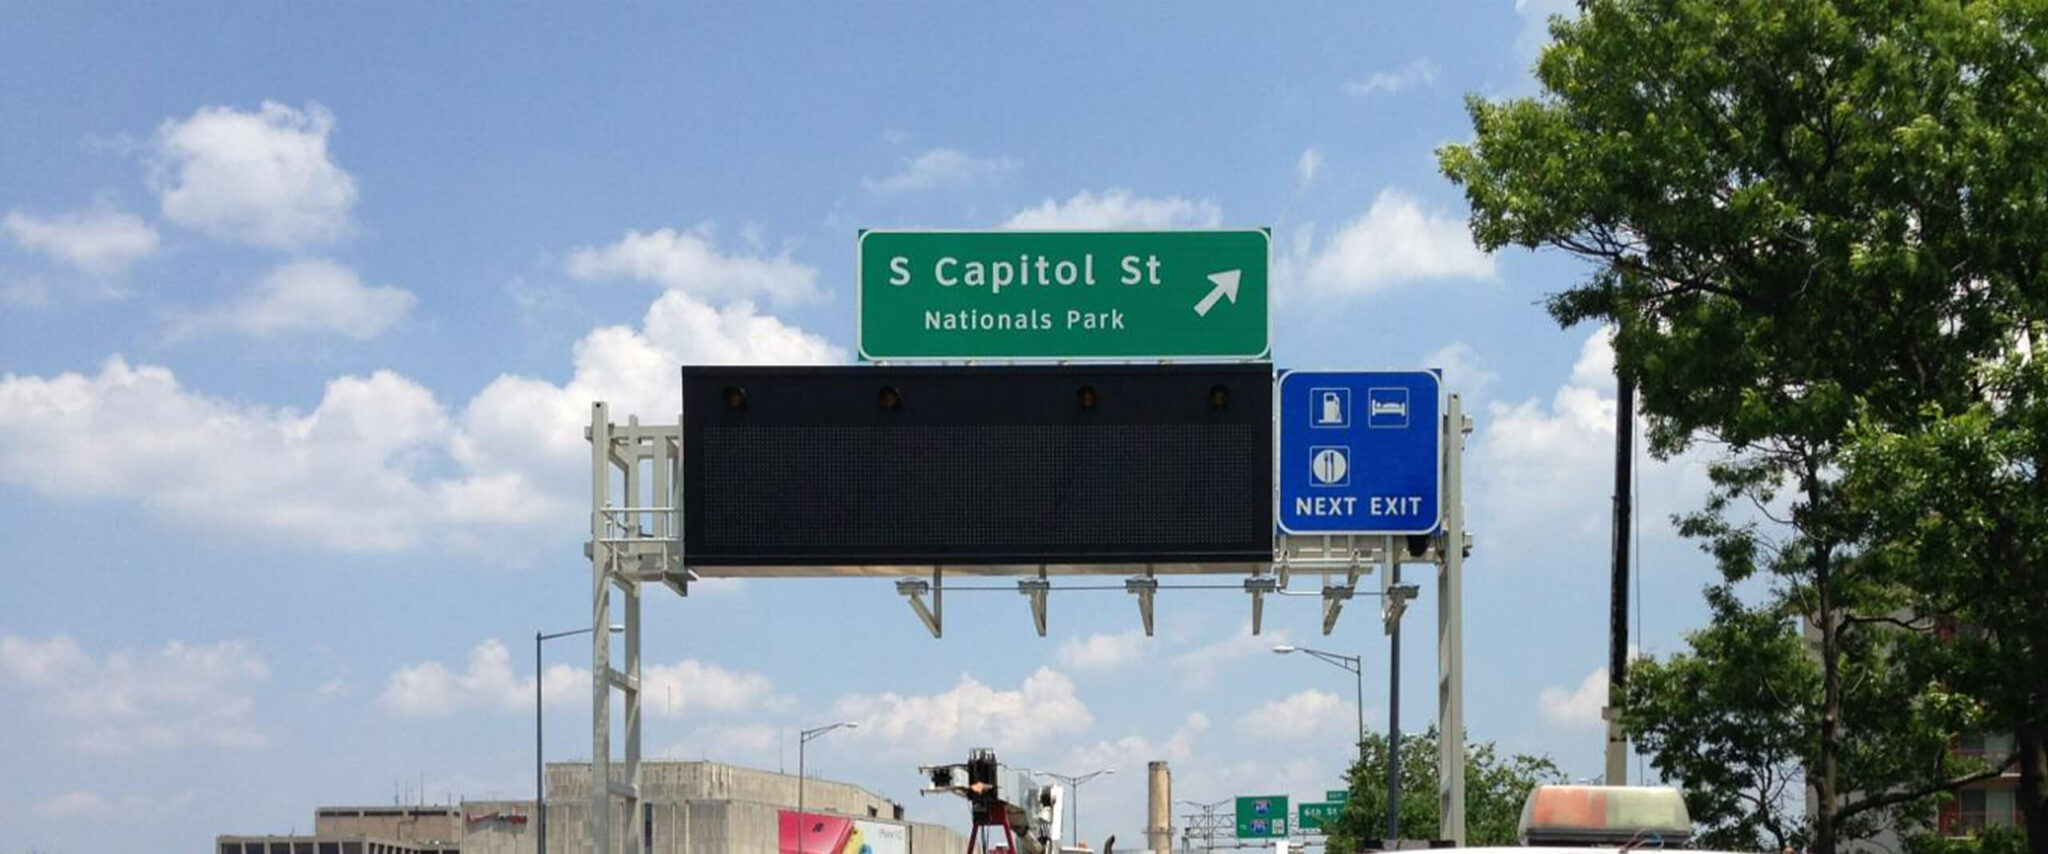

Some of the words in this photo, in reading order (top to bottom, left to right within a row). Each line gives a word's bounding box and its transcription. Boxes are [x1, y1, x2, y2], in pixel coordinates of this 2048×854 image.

[889, 256, 911, 286] S
[934, 253, 1096, 293] Capitol
[1120, 255, 1162, 286] St
[924, 308, 1053, 330] Nationals
[1067, 308, 1126, 330] Park
[1295, 496, 1358, 516] NEXT
[1370, 496, 1423, 516] EXIT
